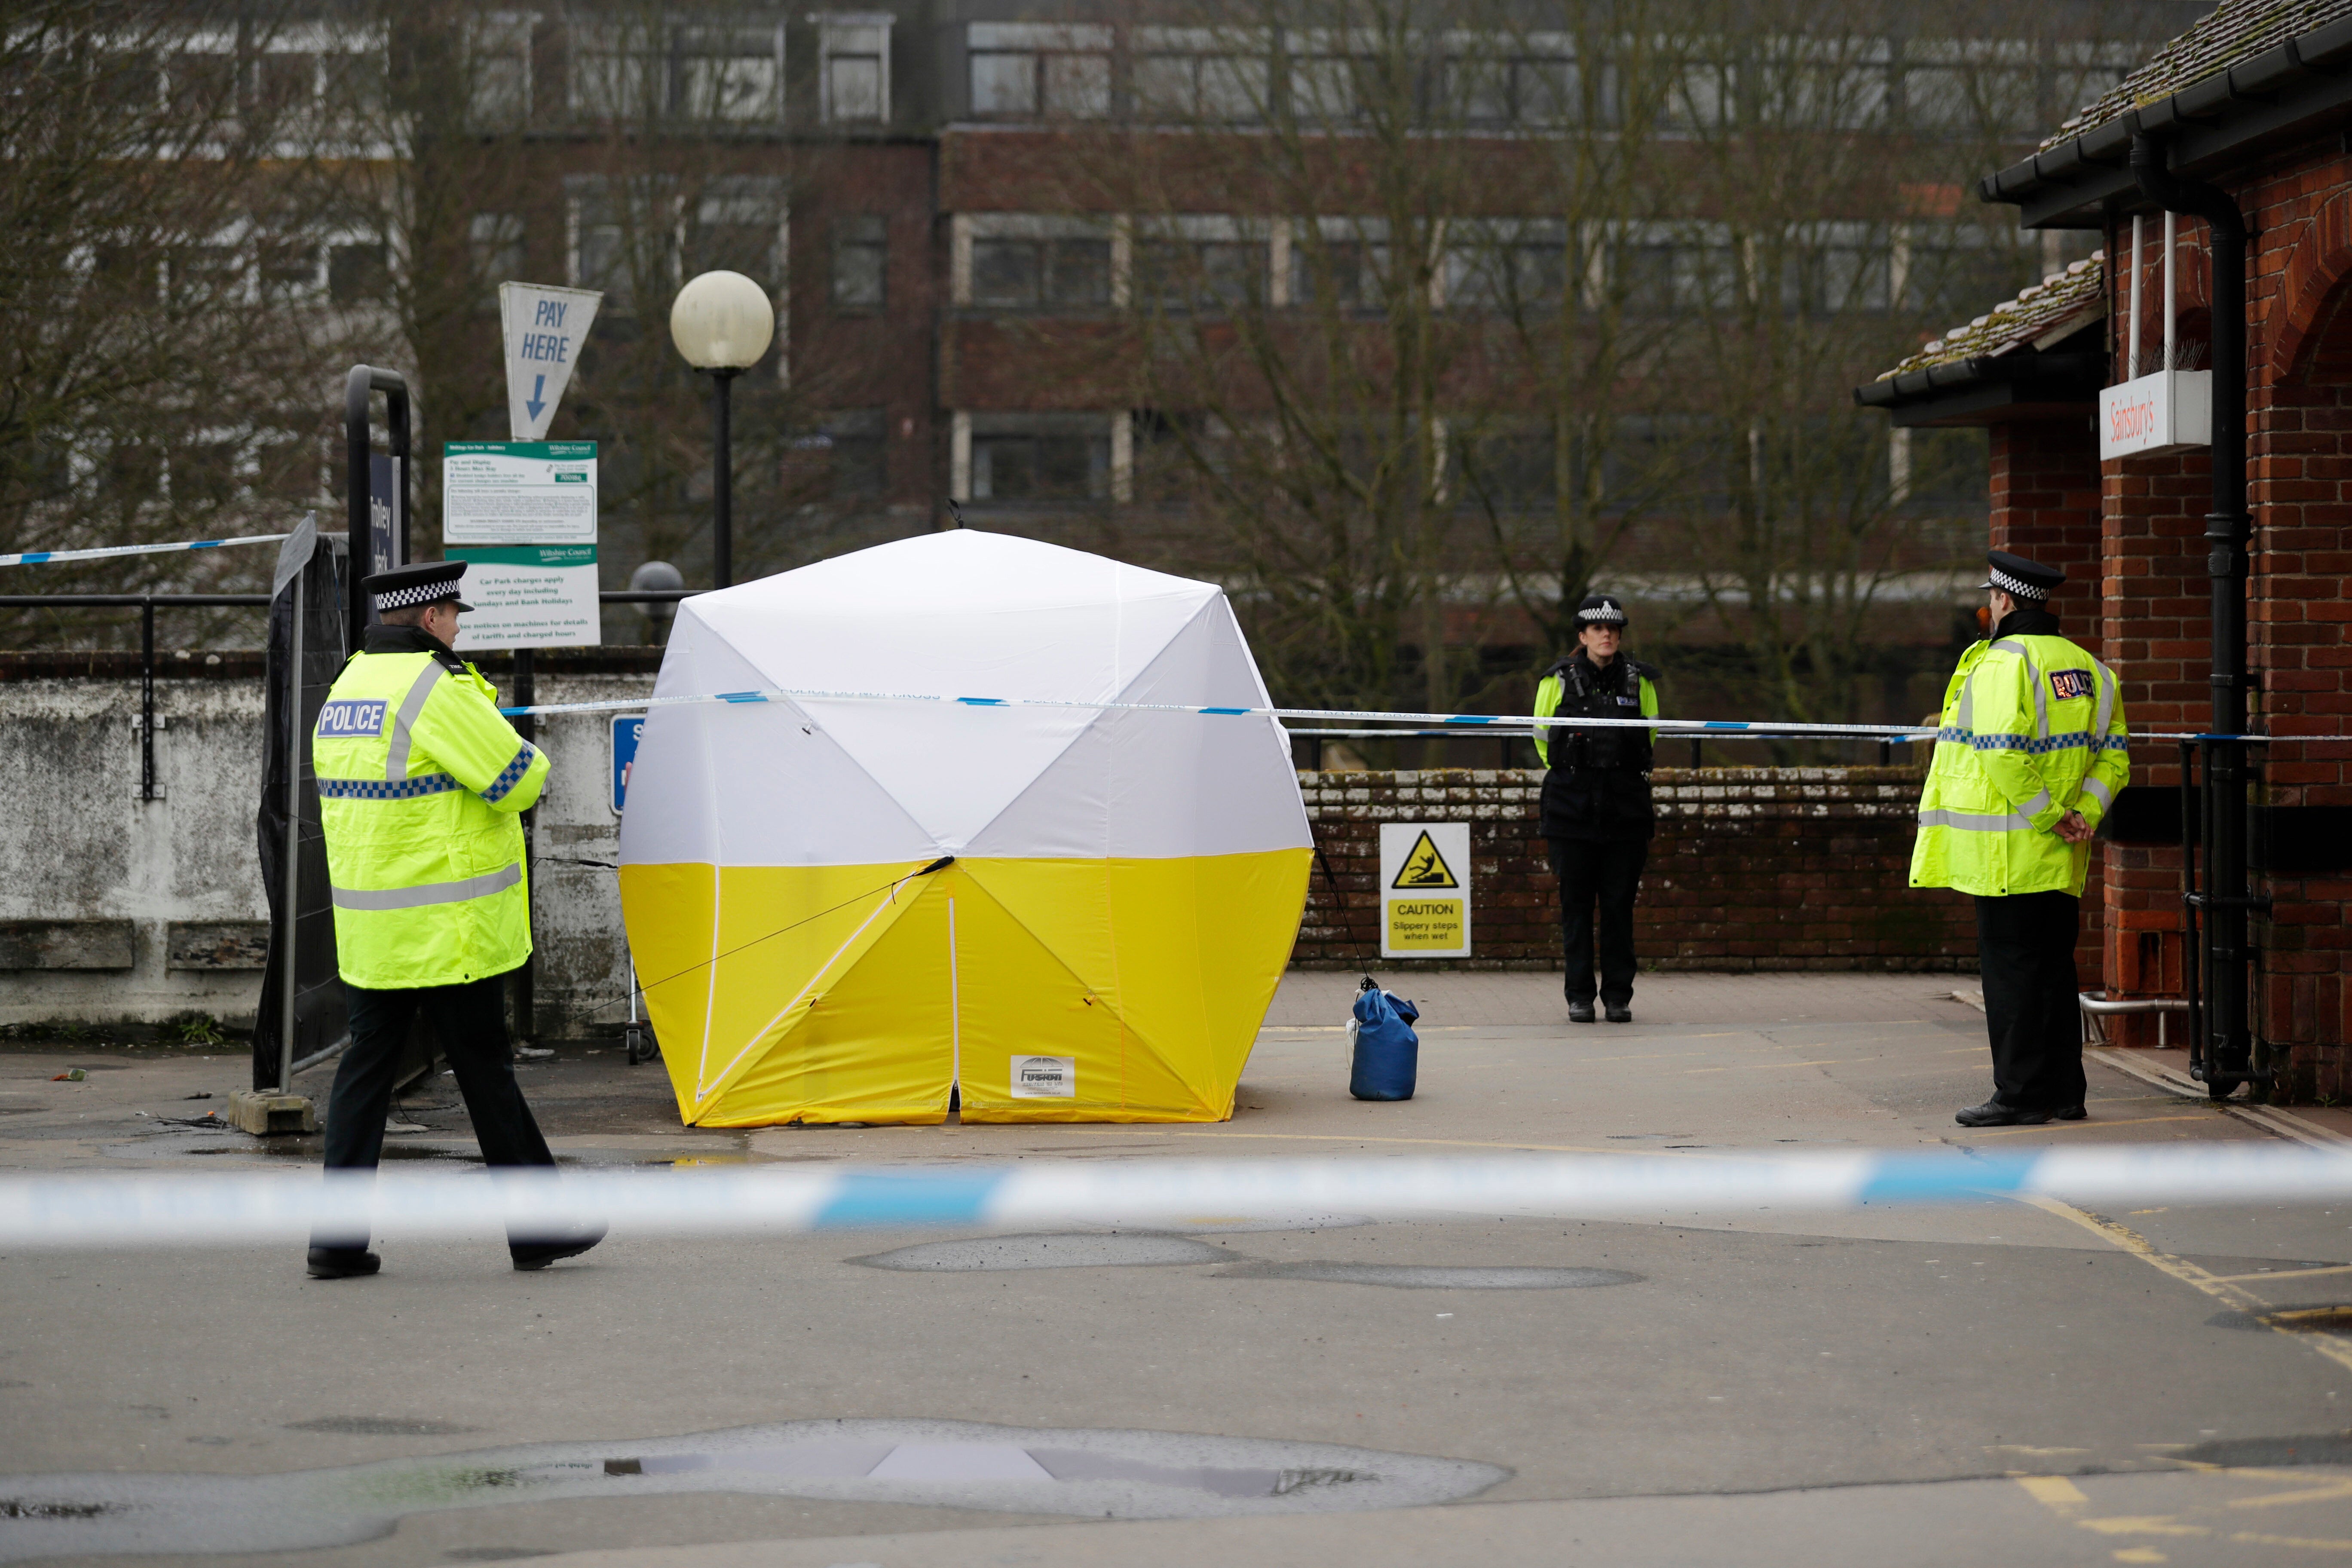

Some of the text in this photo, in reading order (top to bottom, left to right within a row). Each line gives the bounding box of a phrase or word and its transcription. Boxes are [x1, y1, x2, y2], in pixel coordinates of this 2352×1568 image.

[535, 300, 568, 328] PAY
[521, 332, 570, 362] HERE
[2110, 390, 2153, 445] Sainsbury's
[370, 495, 391, 537] Trolley
[539, 549, 567, 557] Wiltshire
[514, 577, 542, 585] charges
[544, 576, 564, 584] apply
[473, 600, 503, 608] Sundays
[542, 597, 573, 605] Holidays
[523, 631, 553, 639] charged
[321, 704, 383, 731] POLICE
[1398, 904, 1453, 915] CAUTION
[1393, 922, 1458, 931] Slippery steps
[1021, 1069, 1063, 1082] Fusion
